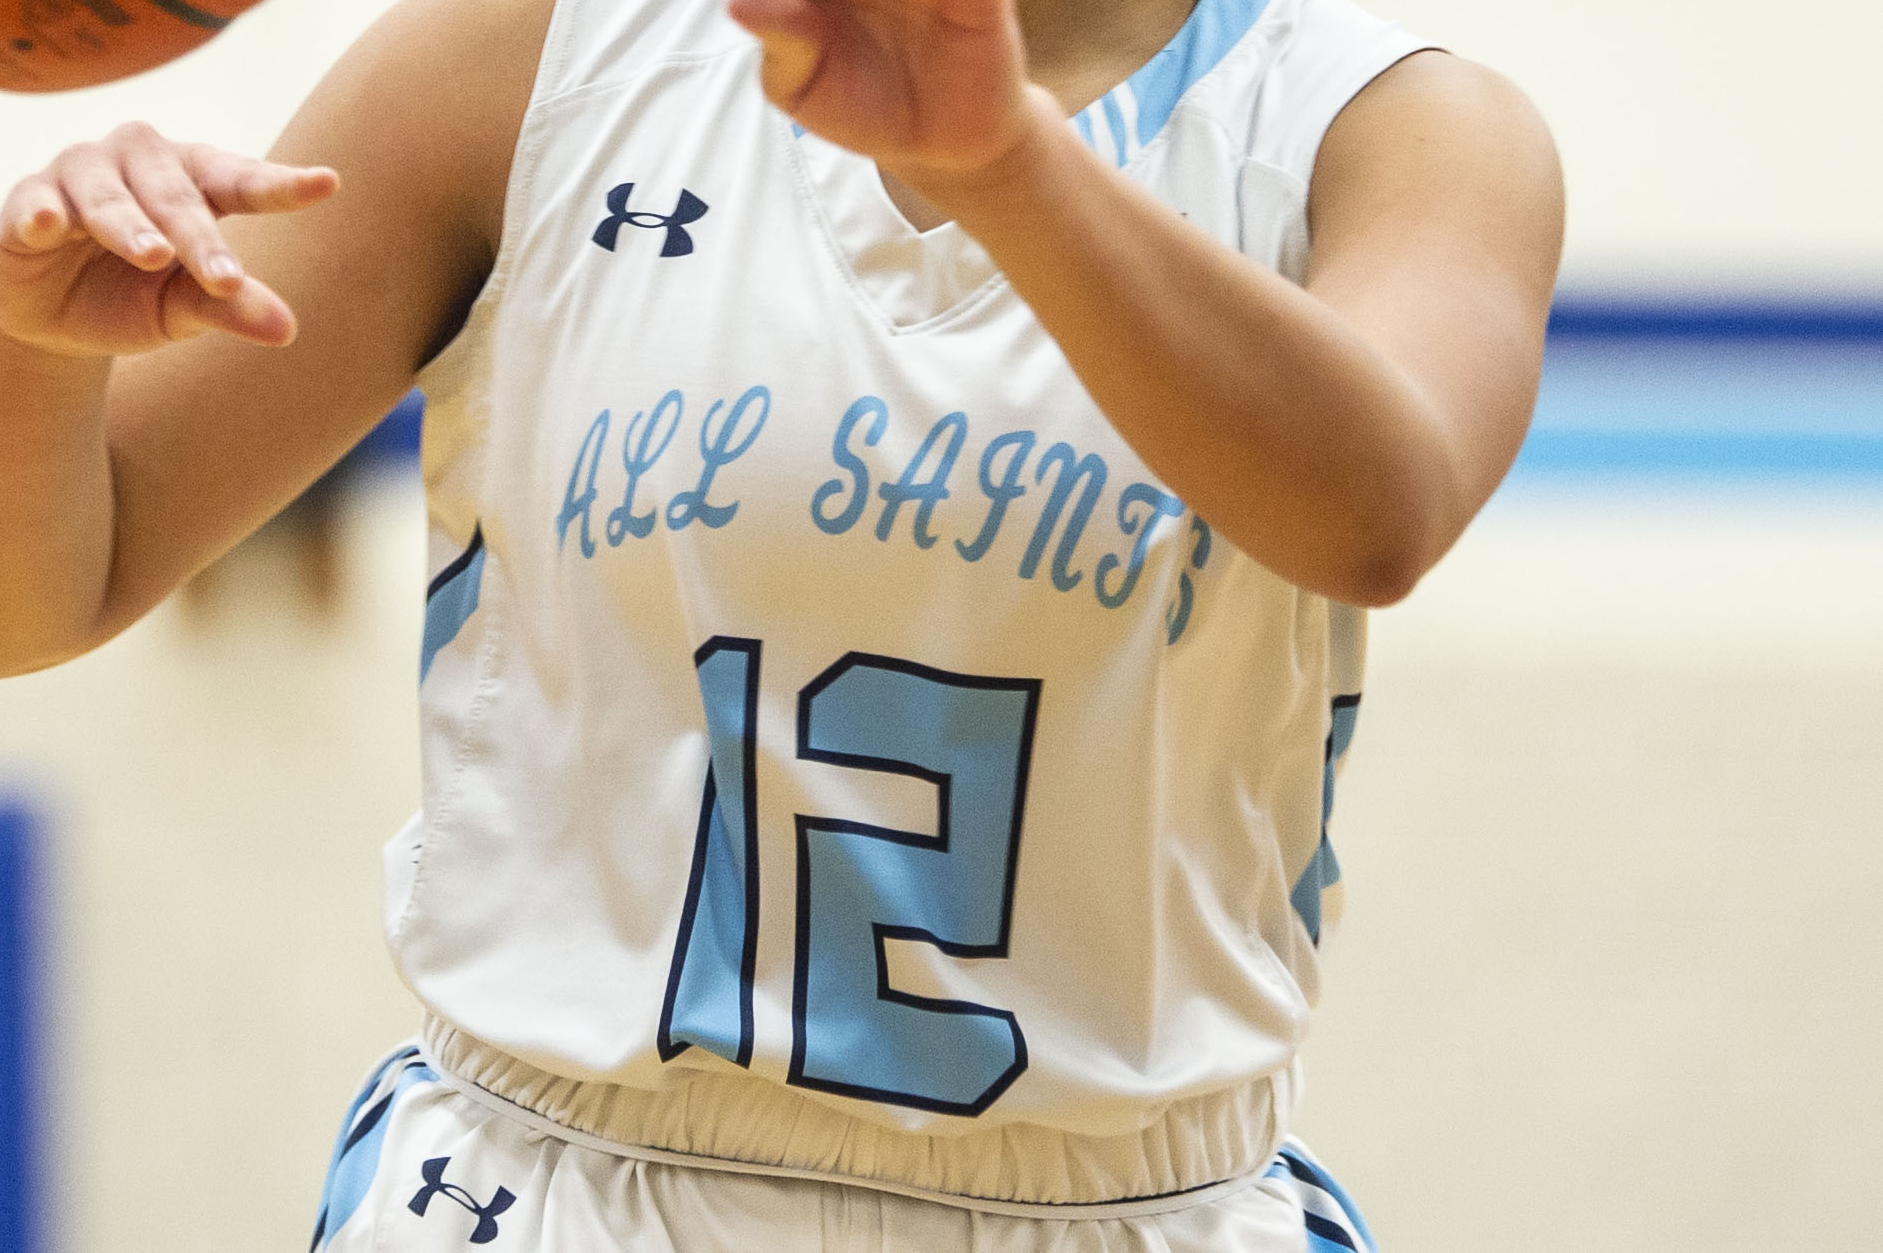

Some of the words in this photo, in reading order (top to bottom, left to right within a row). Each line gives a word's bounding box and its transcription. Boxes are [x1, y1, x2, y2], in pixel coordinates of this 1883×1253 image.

[556, 384, 771, 559] ALL
[810, 395, 1212, 646] SAINTS
[656, 634, 1043, 1118] 12
